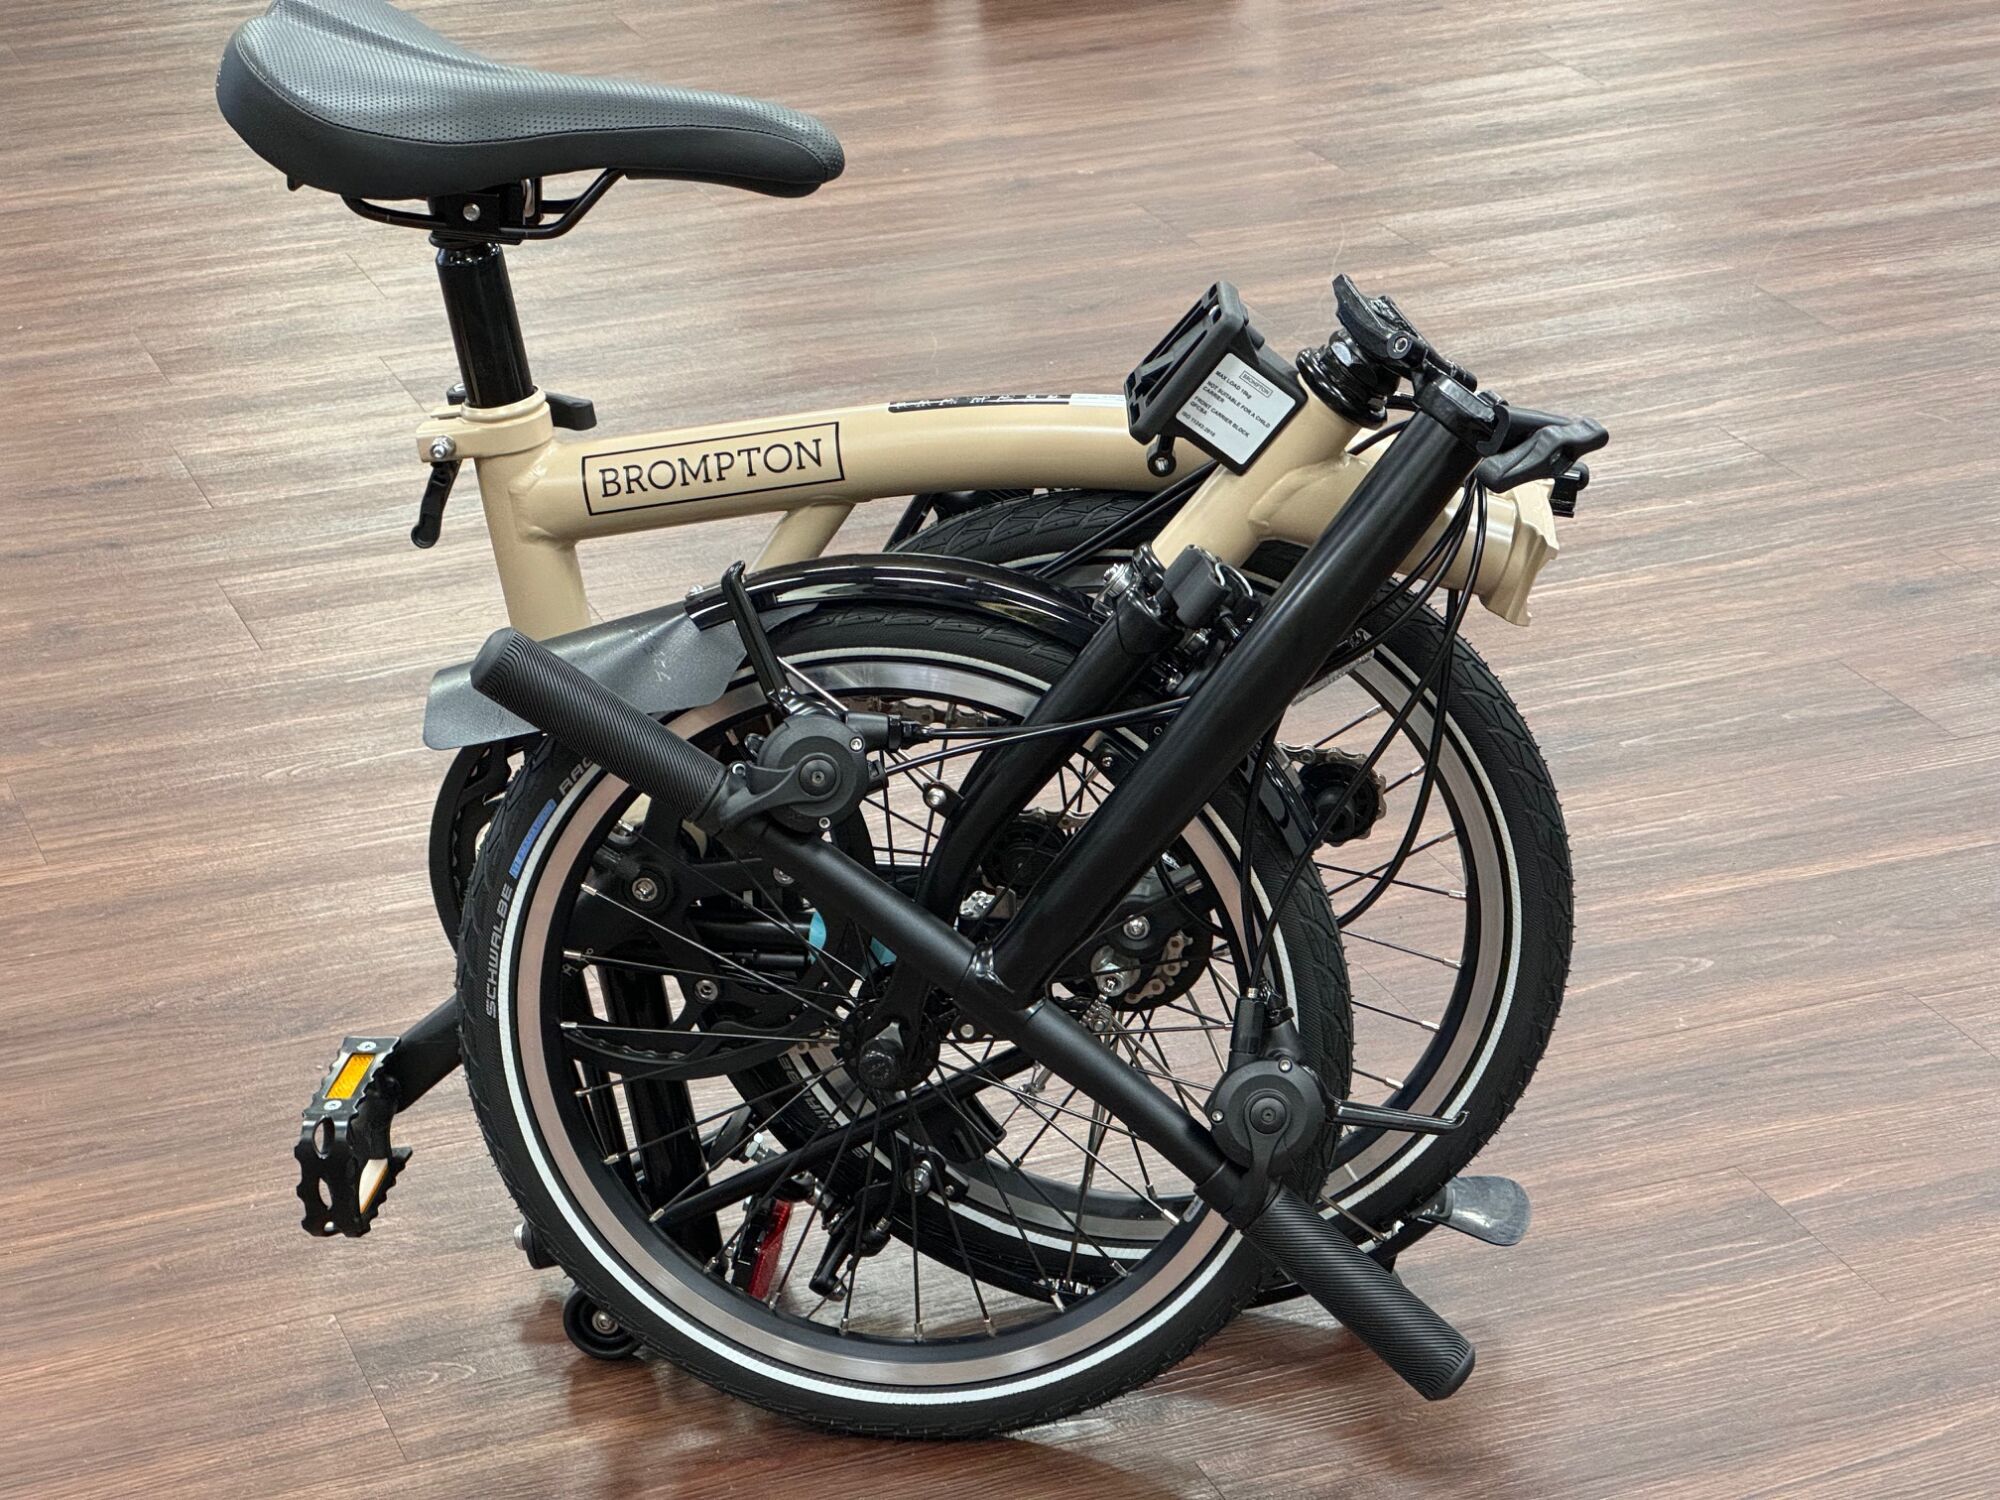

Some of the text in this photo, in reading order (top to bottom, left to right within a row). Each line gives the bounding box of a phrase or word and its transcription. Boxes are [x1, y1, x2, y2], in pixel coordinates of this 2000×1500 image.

[1202, 386, 1225, 403] CARRIER
[1215, 370, 1228, 381] MAX
[1227, 379, 1241, 391] LOAD
[1194, 396, 1250, 438] FRONT CARRIER BLOCK
[1207, 381, 1218, 390] NOT
[1217, 387, 1241, 407] SUITABLE
[1240, 404, 1252, 415] FOR
[1255, 415, 1271, 428] CHILD
[599, 438, 823, 498] BROMPTON
[558, 756, 593, 796] RAC
[485, 882, 514, 1020] SCHWALBE
